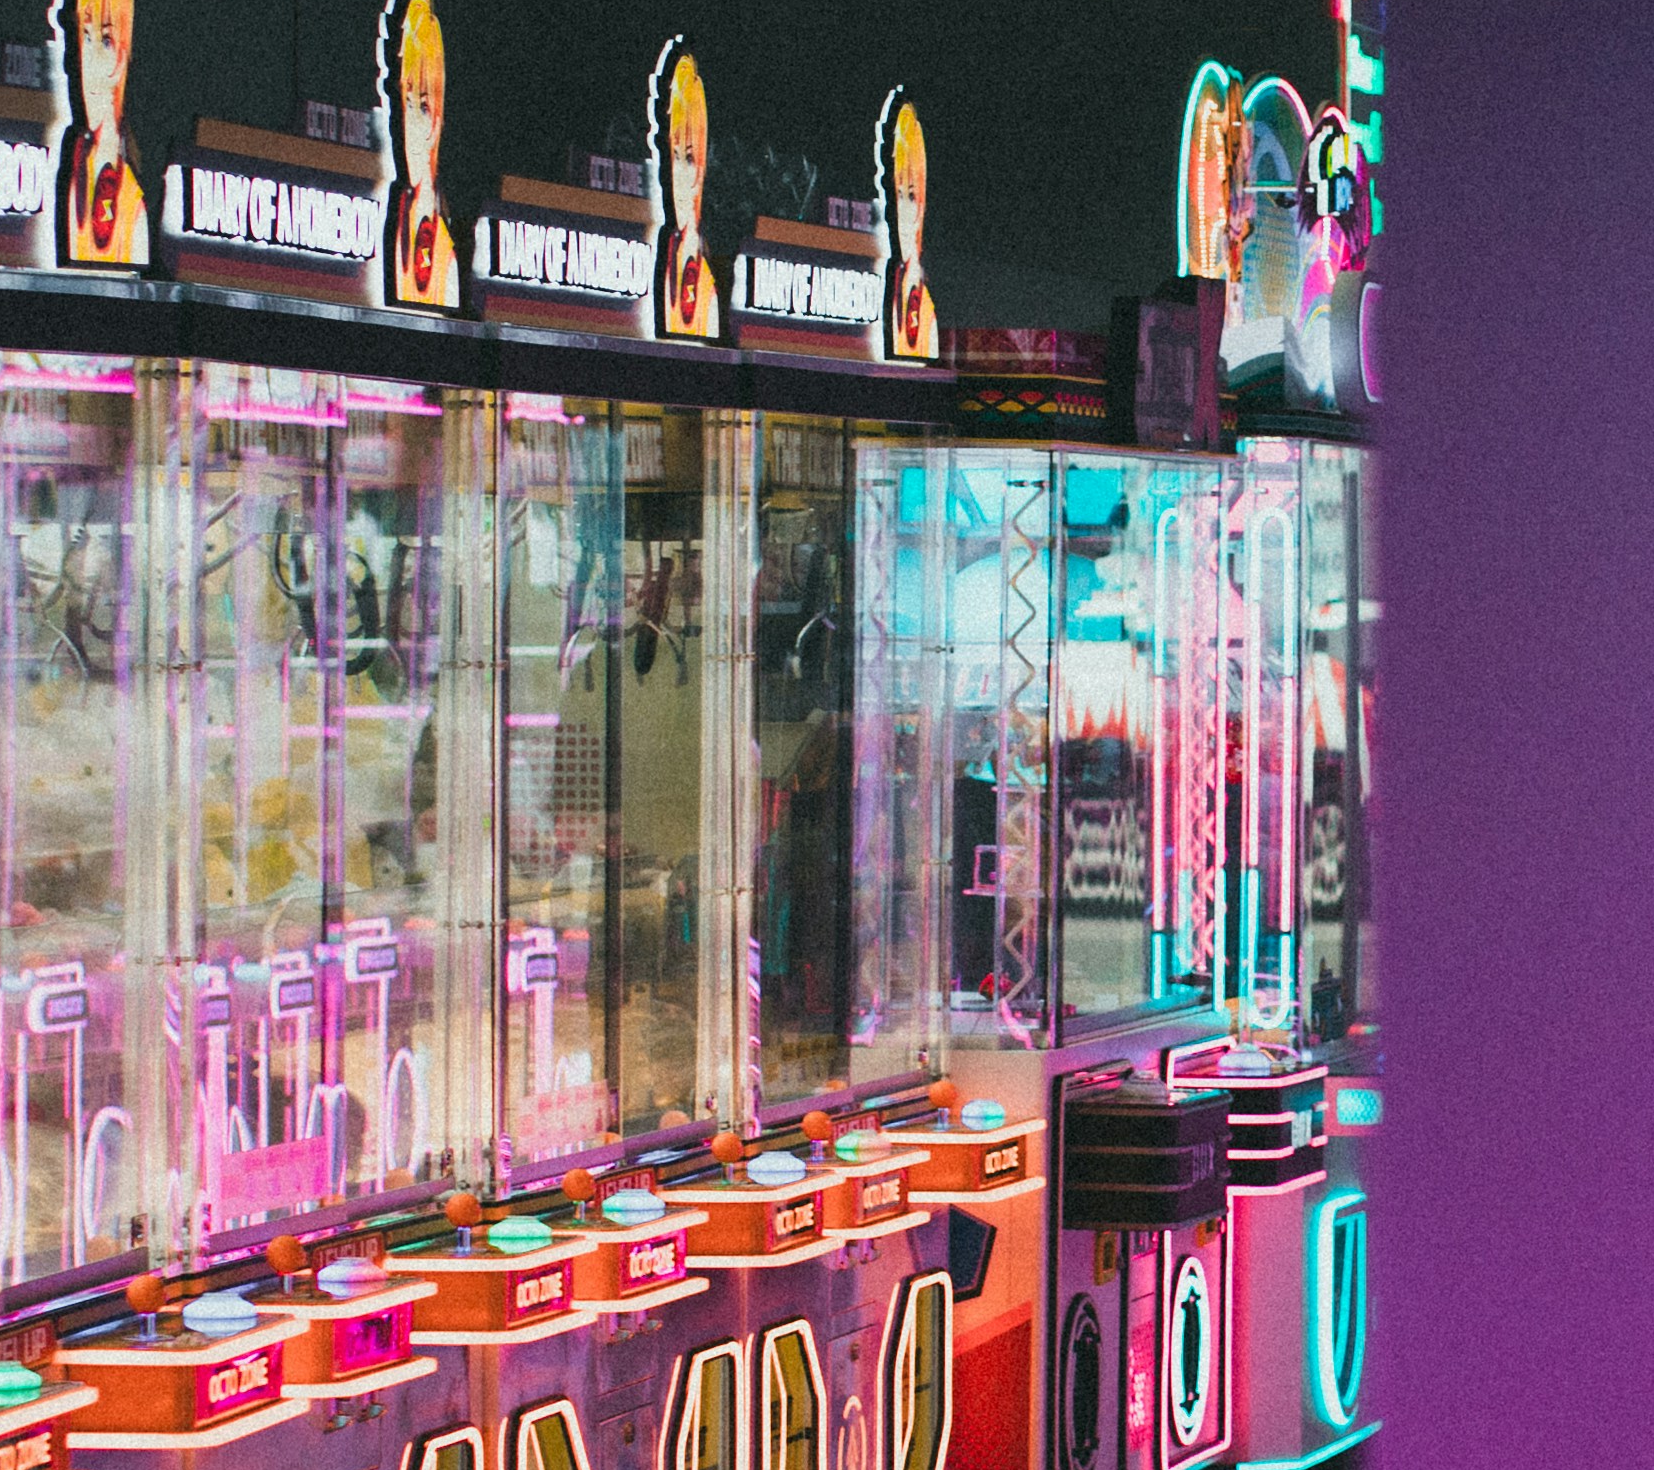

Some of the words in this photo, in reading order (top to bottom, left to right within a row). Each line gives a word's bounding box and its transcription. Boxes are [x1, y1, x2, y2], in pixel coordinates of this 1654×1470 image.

[193, 168, 250, 237] DIARY
[249, 177, 277, 241] OF
[276, 183, 293, 243] A
[499, 220, 546, 279] DIARY
[545, 227, 566, 282] OF
[566, 231, 580, 284] A
[754, 257, 794, 310] DIARY
[792, 264, 811, 313] OF
[810, 266, 821, 314] A
[24, 1326, 47, 1364] UP
[209, 1368, 238, 1403] OCTO
[239, 1357, 268, 1392] ZONE
